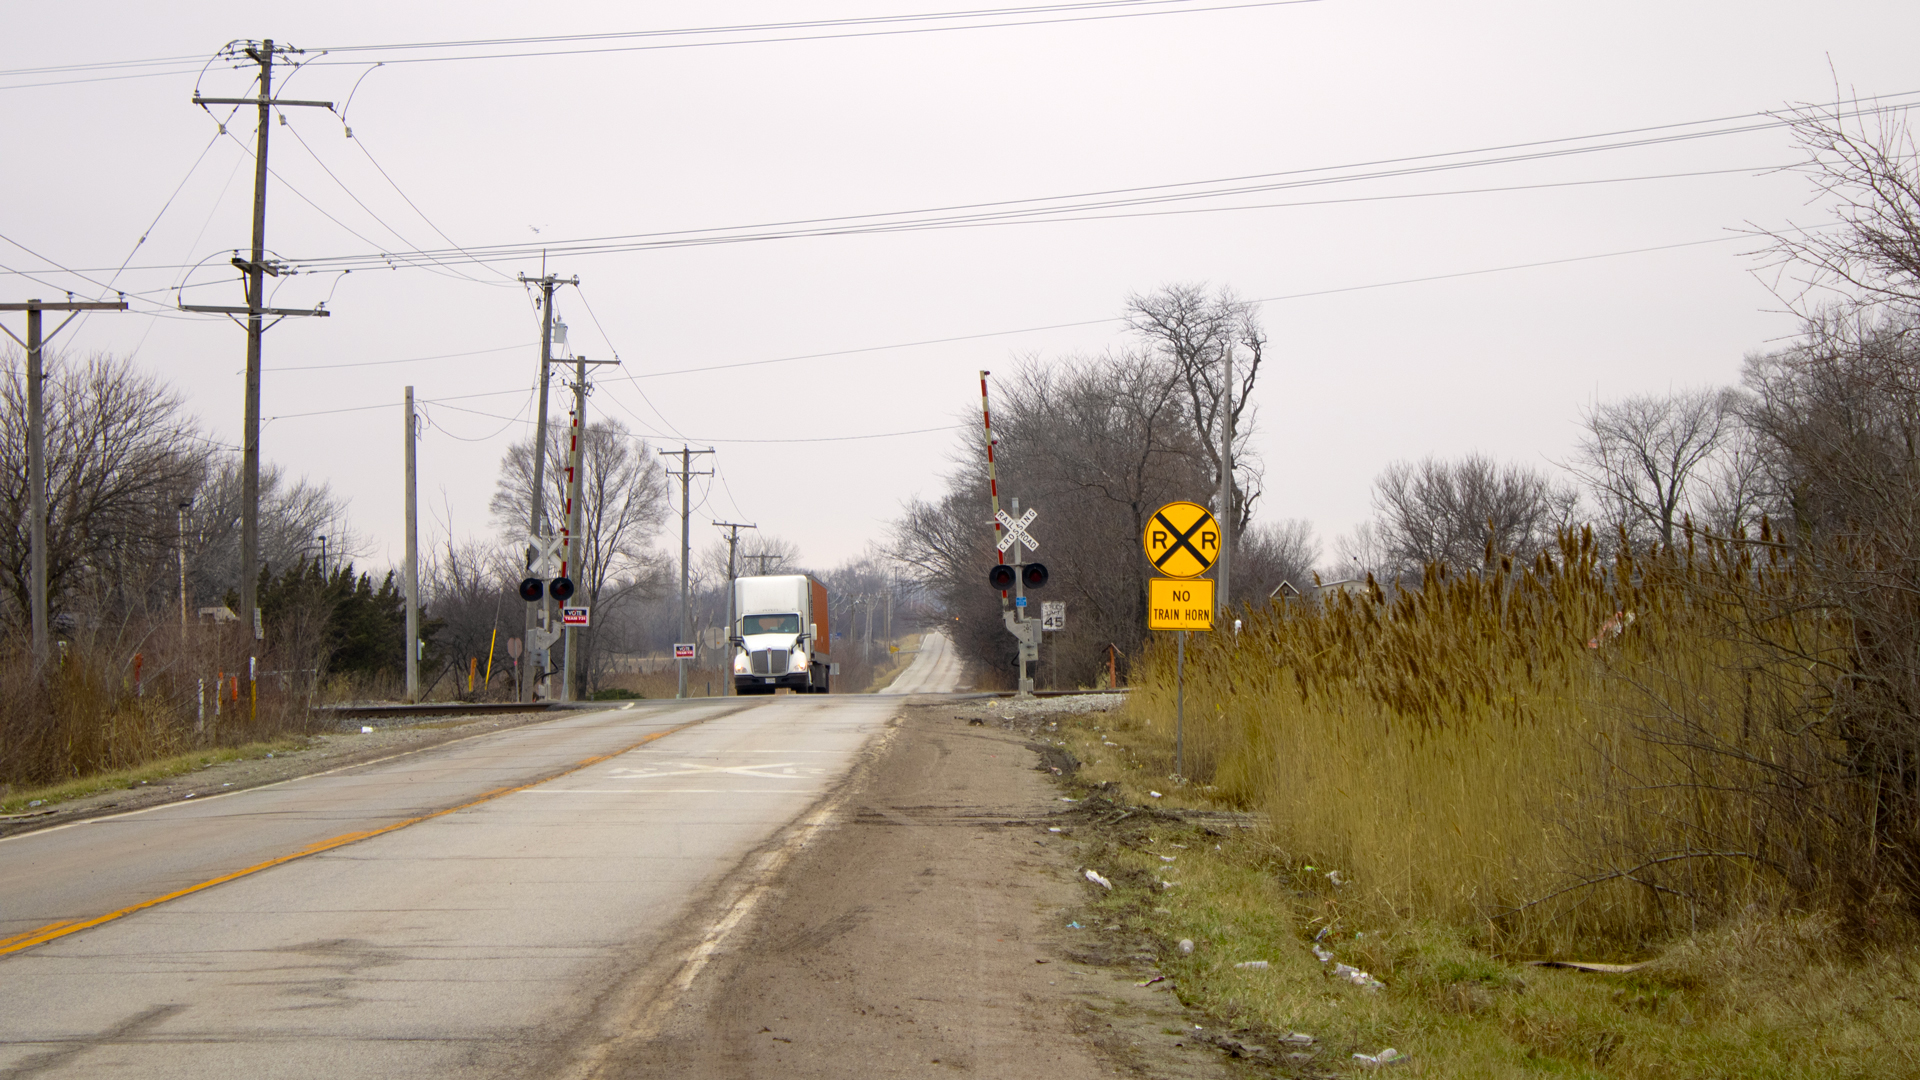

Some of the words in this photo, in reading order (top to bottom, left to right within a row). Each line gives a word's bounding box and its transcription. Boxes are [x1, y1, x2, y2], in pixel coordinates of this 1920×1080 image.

[999, 510, 1036, 551] CROSSING
[1152, 530, 1168, 550] R
[1201, 531, 1217, 550] R
[1172, 590, 1191, 602] NO
[1153, 608, 1180, 621] TRAIN
[1185, 609, 1210, 621] HORN
[1044, 616, 1063, 628] 45
